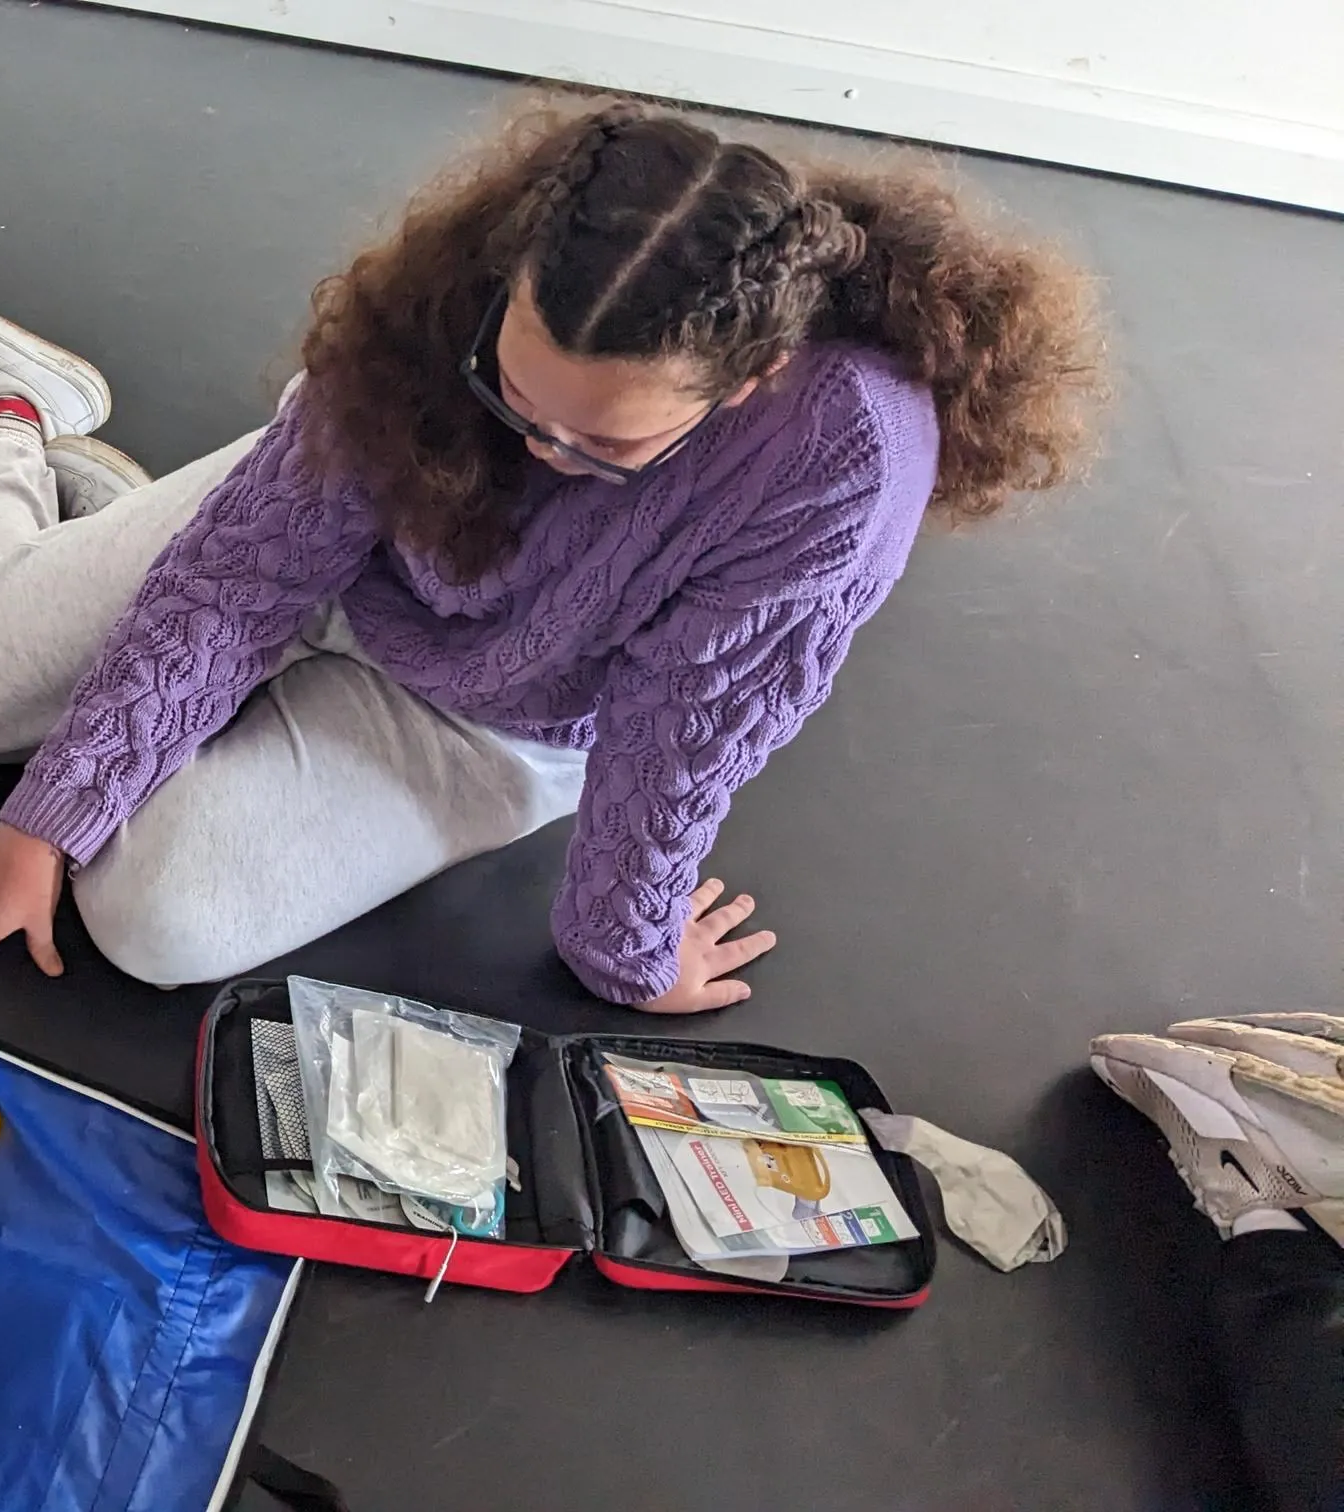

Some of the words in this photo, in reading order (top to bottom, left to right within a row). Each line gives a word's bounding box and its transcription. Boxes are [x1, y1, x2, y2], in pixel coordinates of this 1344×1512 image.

[693, 1144, 719, 1181] Trainer
[715, 1180, 734, 1202] AED
[728, 1201, 748, 1224] Mini
